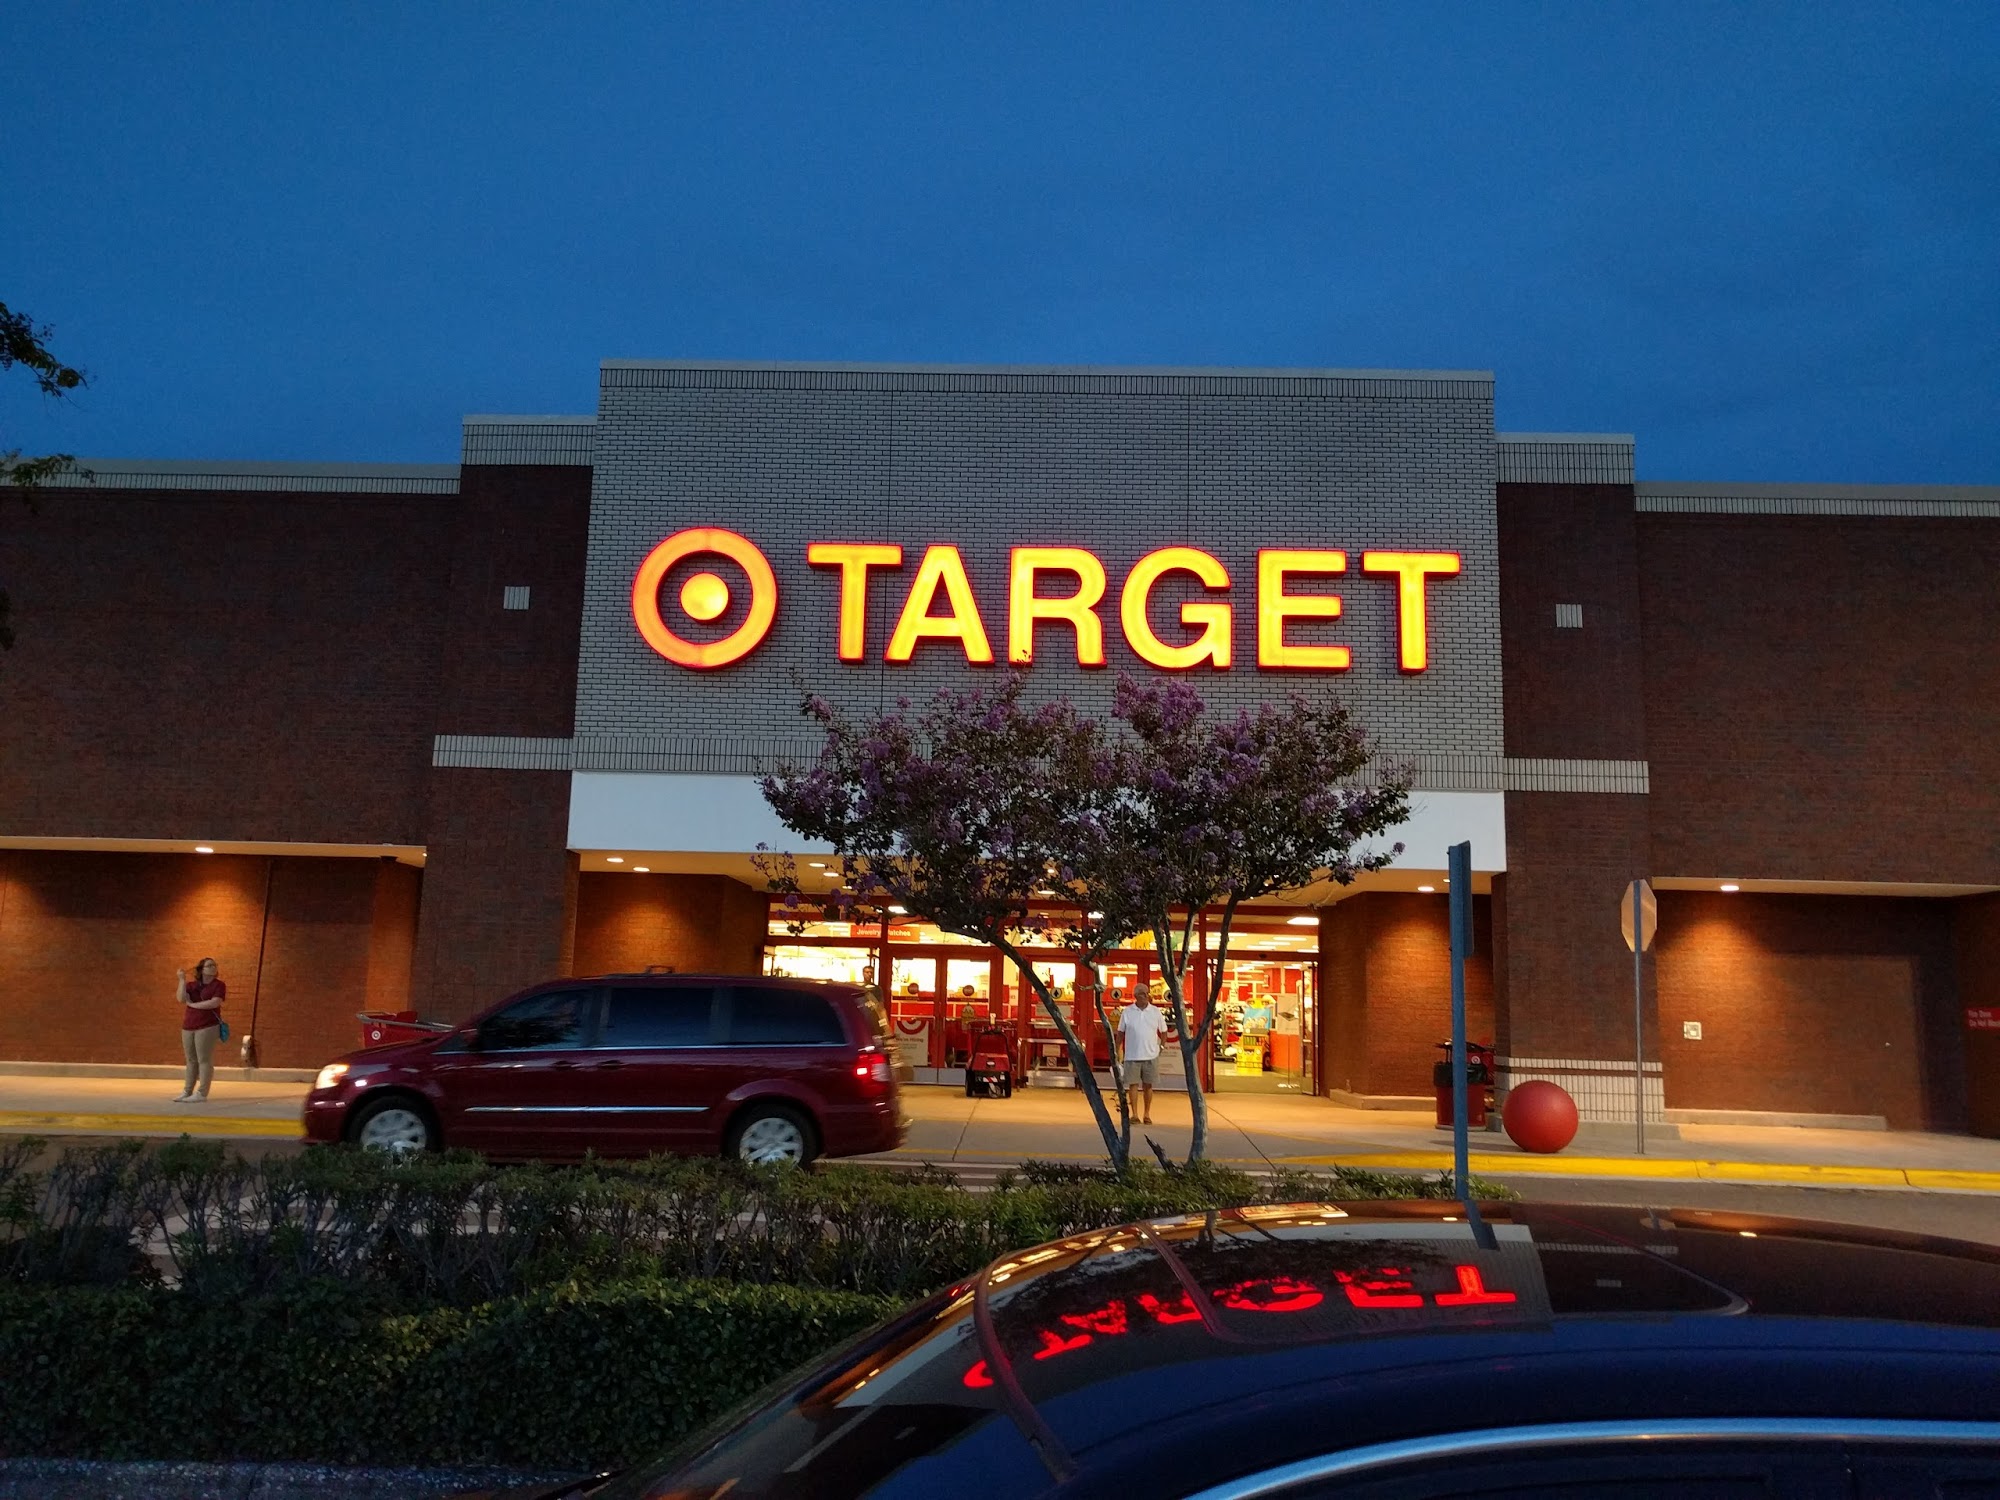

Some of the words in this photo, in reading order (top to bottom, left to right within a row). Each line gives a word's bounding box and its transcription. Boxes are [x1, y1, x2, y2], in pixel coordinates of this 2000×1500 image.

[806, 542, 1462, 671] TARGET
[856, 928, 881, 937] Jewelry
[888, 929, 911, 937] atches
